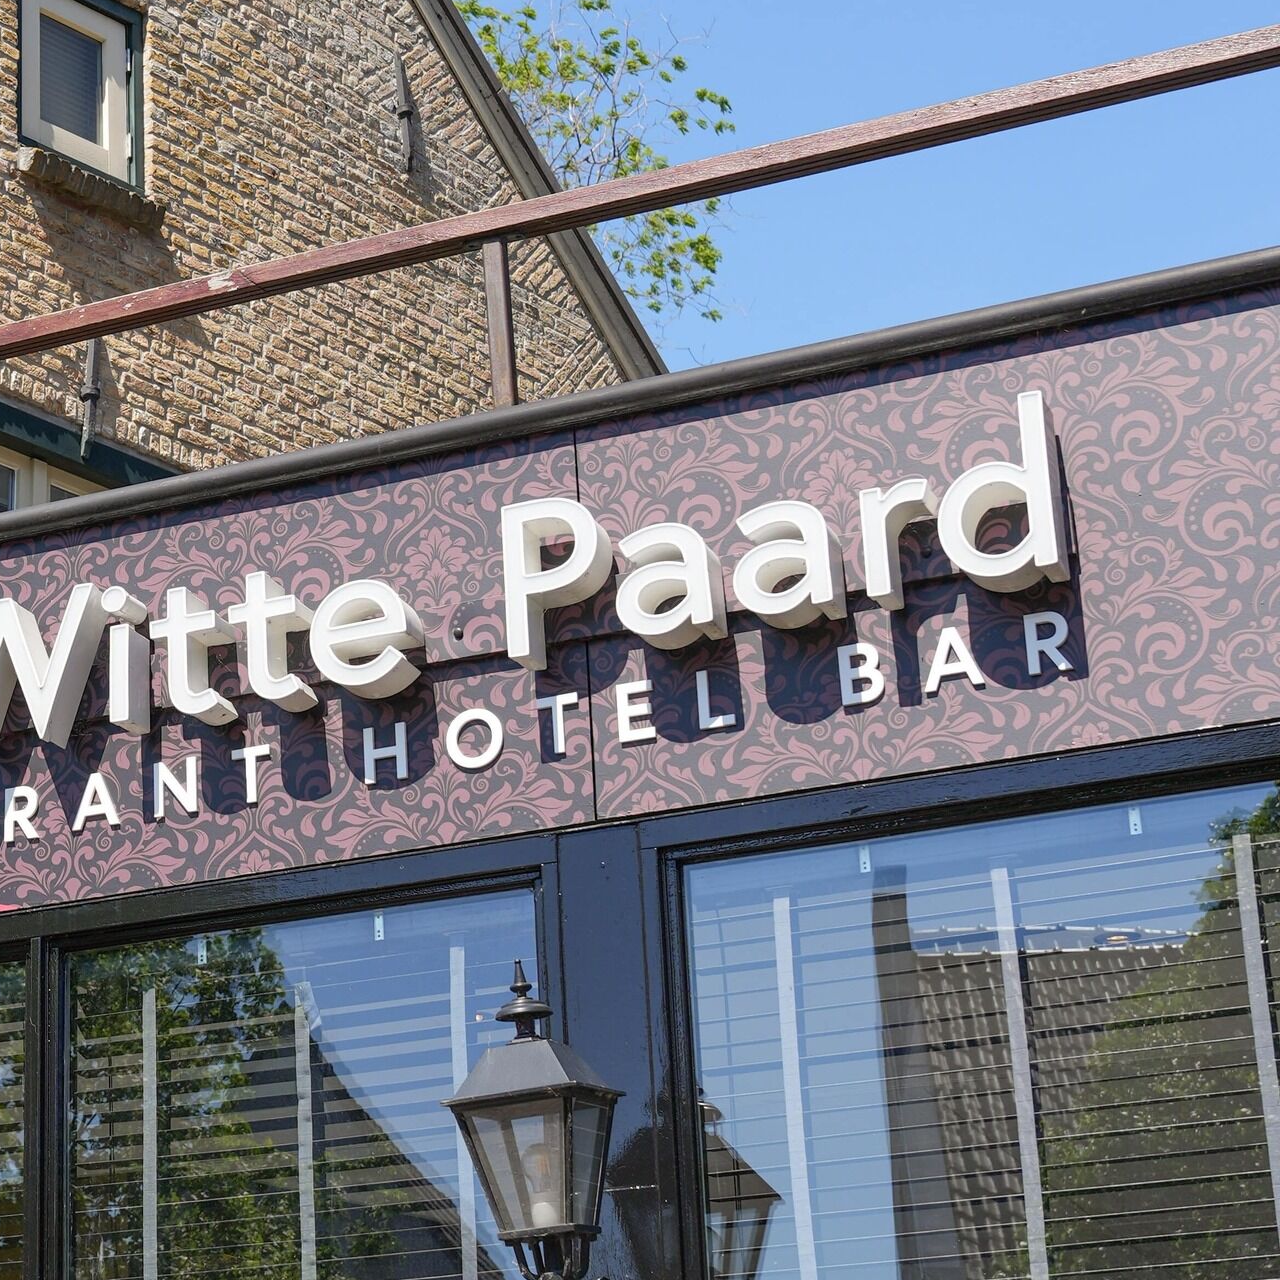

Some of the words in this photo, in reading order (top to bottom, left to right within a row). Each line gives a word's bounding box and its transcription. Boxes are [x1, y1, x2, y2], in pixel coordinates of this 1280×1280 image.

[501, 391, 1073, 670] Paard
[362, 669, 737, 785] HOTEL
[837, 609, 1074, 709] BAR
